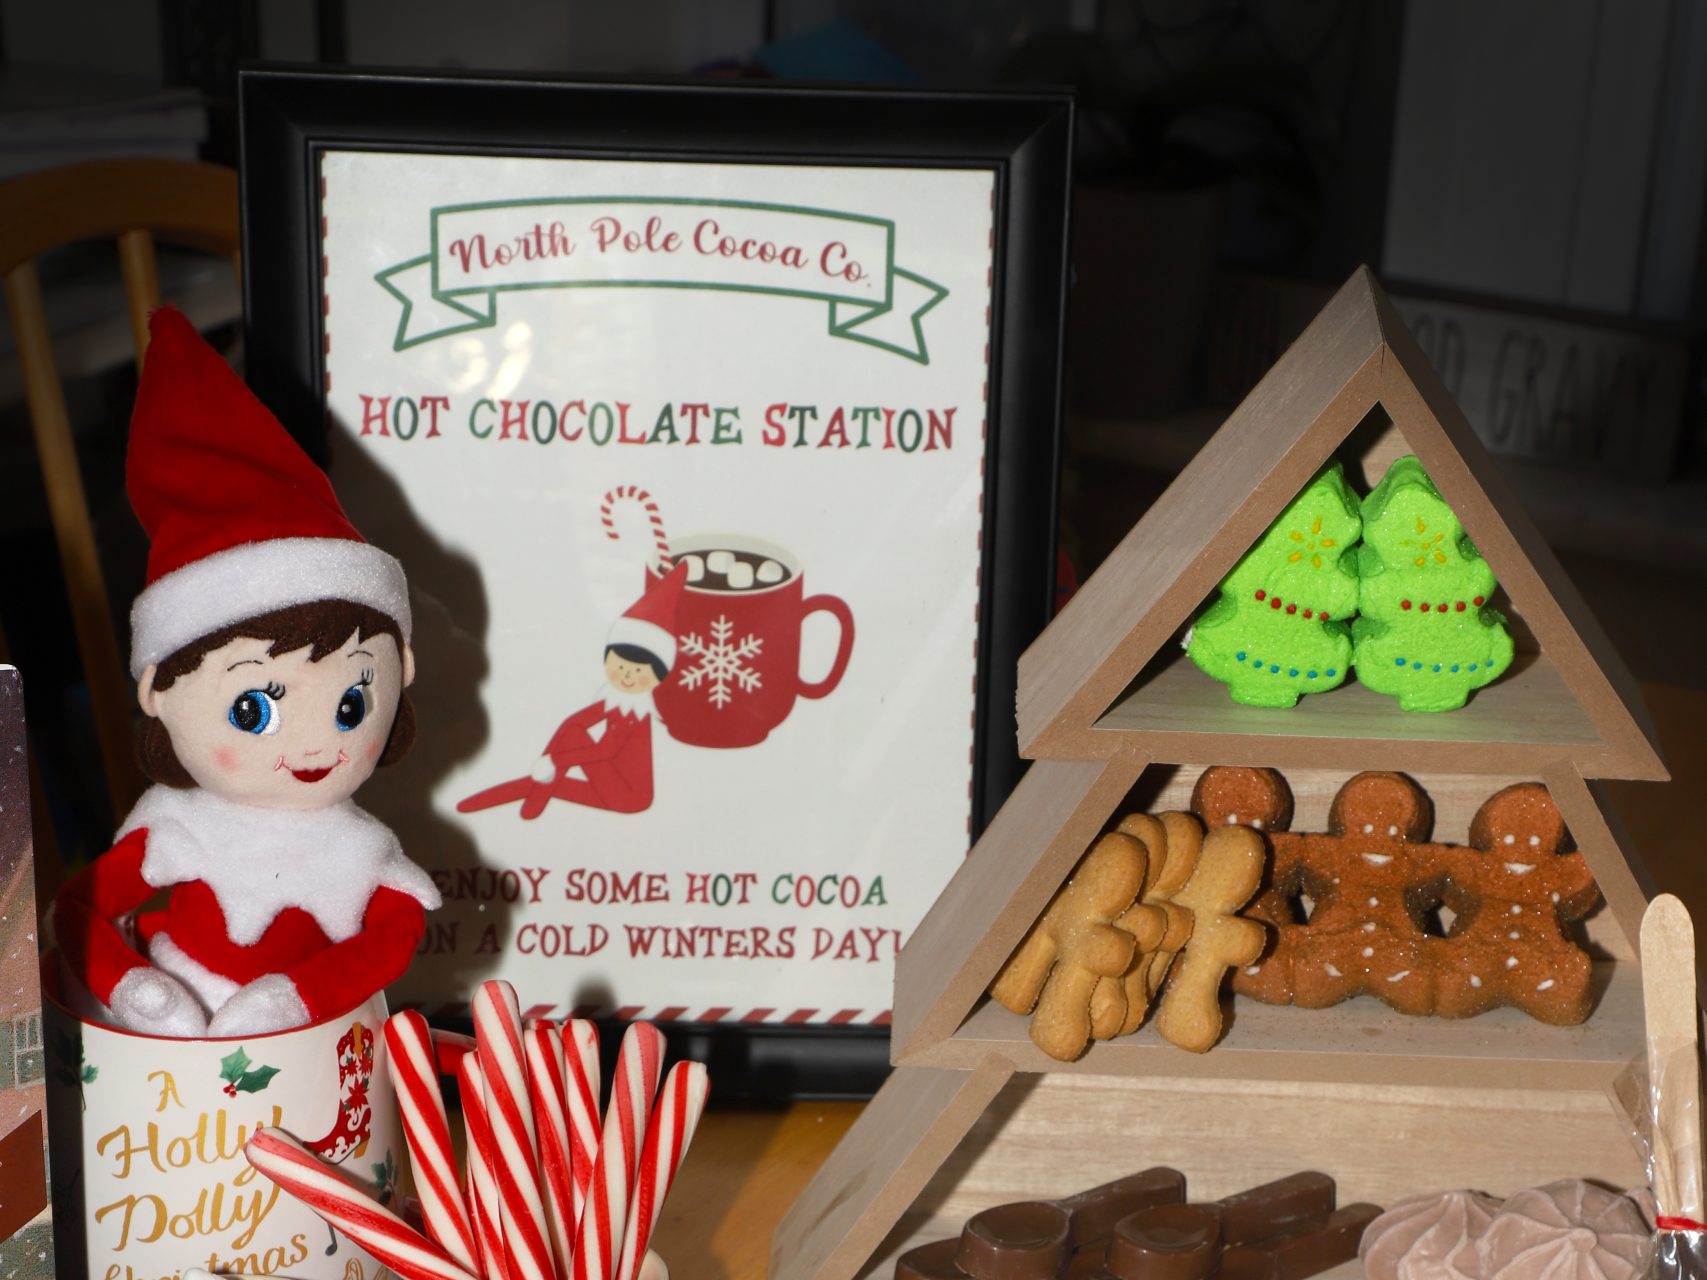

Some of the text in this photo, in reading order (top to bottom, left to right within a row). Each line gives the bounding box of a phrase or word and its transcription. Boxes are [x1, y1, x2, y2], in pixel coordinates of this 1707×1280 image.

[449, 215, 874, 289] North Pole Cocoa Co.
[358, 393, 957, 453] HOT CHOCOLATE STATION
[432, 866, 888, 909] ENJOY SOME HOT COCOA
[474, 922, 502, 955] A
[516, 923, 609, 958] COLD
[623, 924, 796, 960] WINTERS
[147, 1070, 186, 1112] A
[96, 1104, 283, 1187] Holly
[95, 1182, 281, 1252] Dolly
